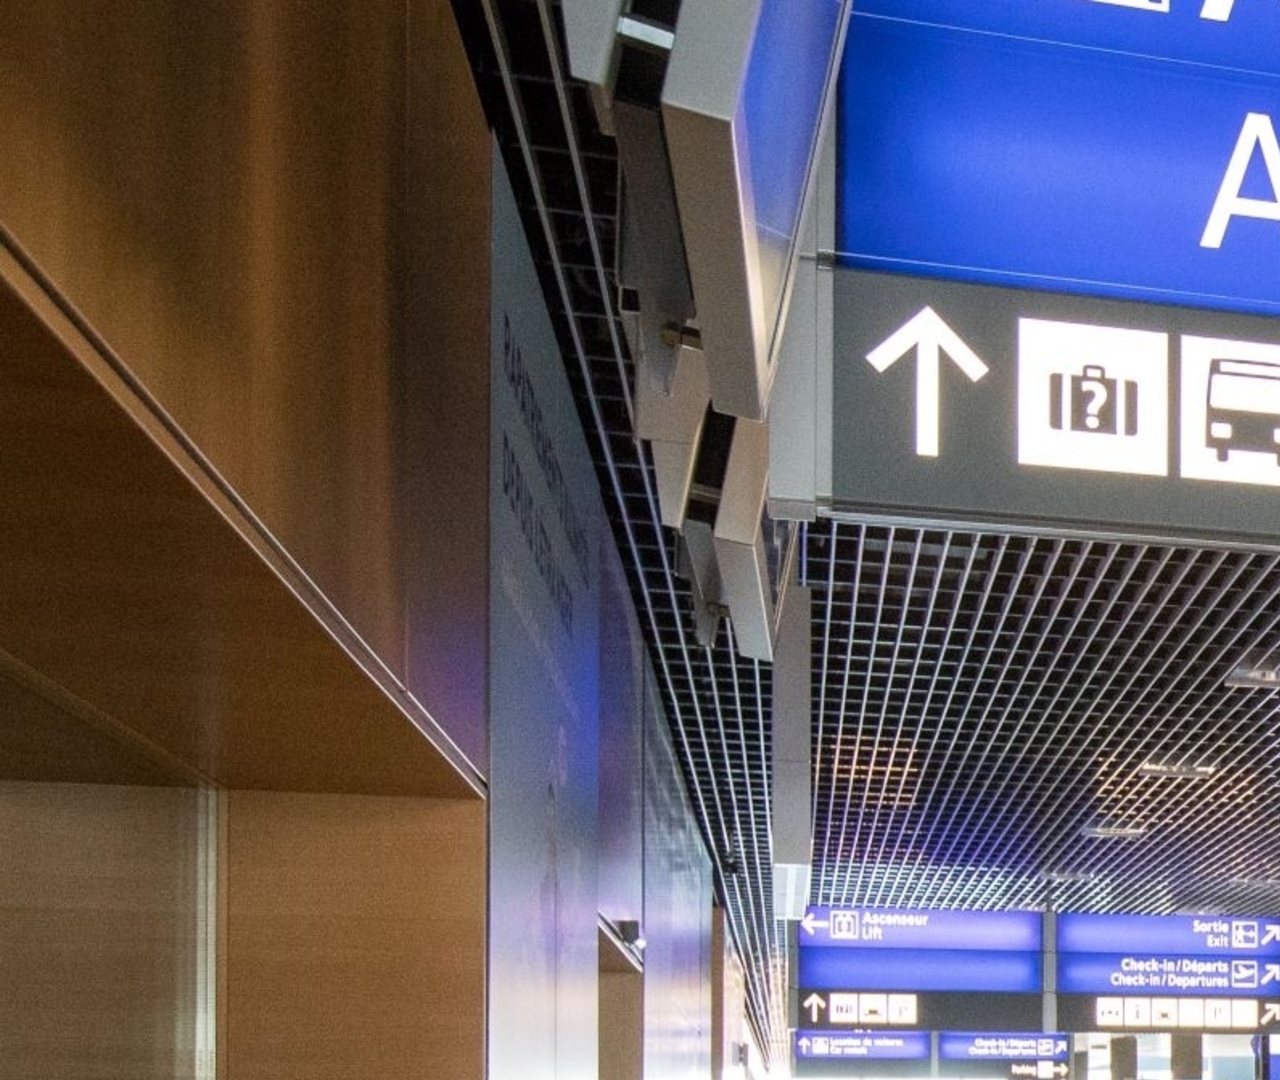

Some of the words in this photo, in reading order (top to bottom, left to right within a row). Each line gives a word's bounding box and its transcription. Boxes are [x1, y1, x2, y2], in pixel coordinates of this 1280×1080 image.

[862, 912, 930, 927] Ascenseur
[1192, 919, 1230, 934] Sortie
[862, 926, 883, 941] Lift
[1207, 935, 1230, 948] Exit
